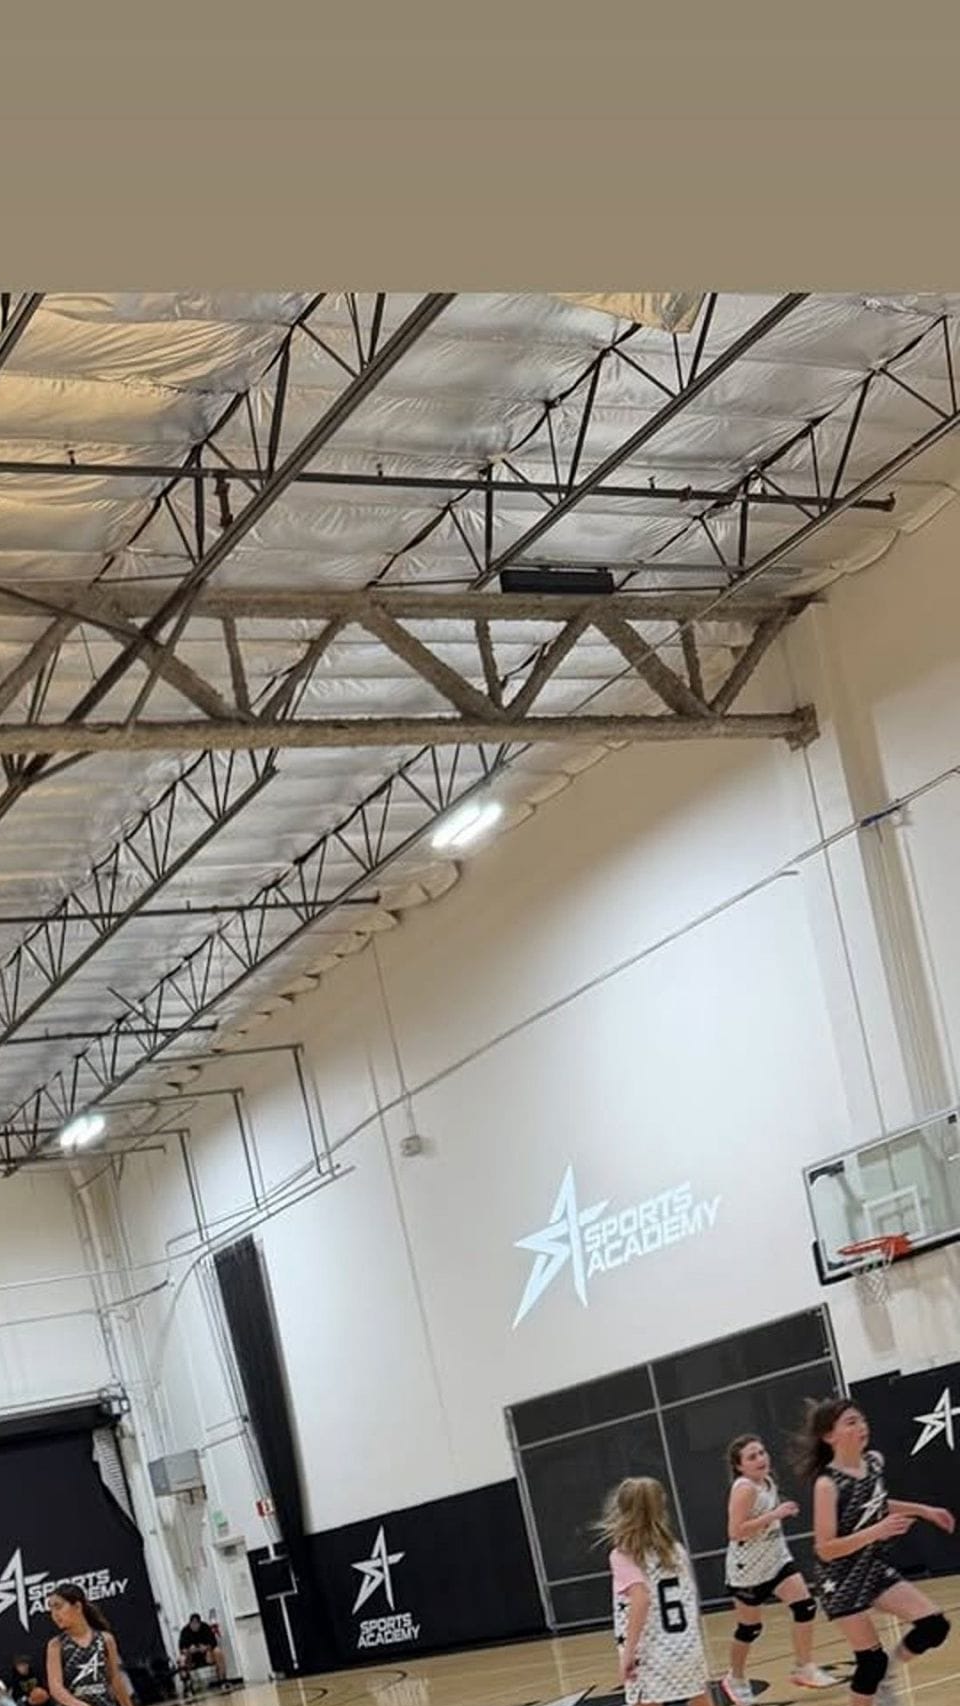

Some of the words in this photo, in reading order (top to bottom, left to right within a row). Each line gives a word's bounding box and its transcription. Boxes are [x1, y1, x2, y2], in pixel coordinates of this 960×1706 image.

[583, 1181, 692, 1252] SPORTS
[587, 1194, 722, 1279] ACADEMY
[360, 1612, 412, 1635] SPORTS
[658, 1577, 688, 1634] 6
[357, 1623, 420, 1649] ACADEMY
